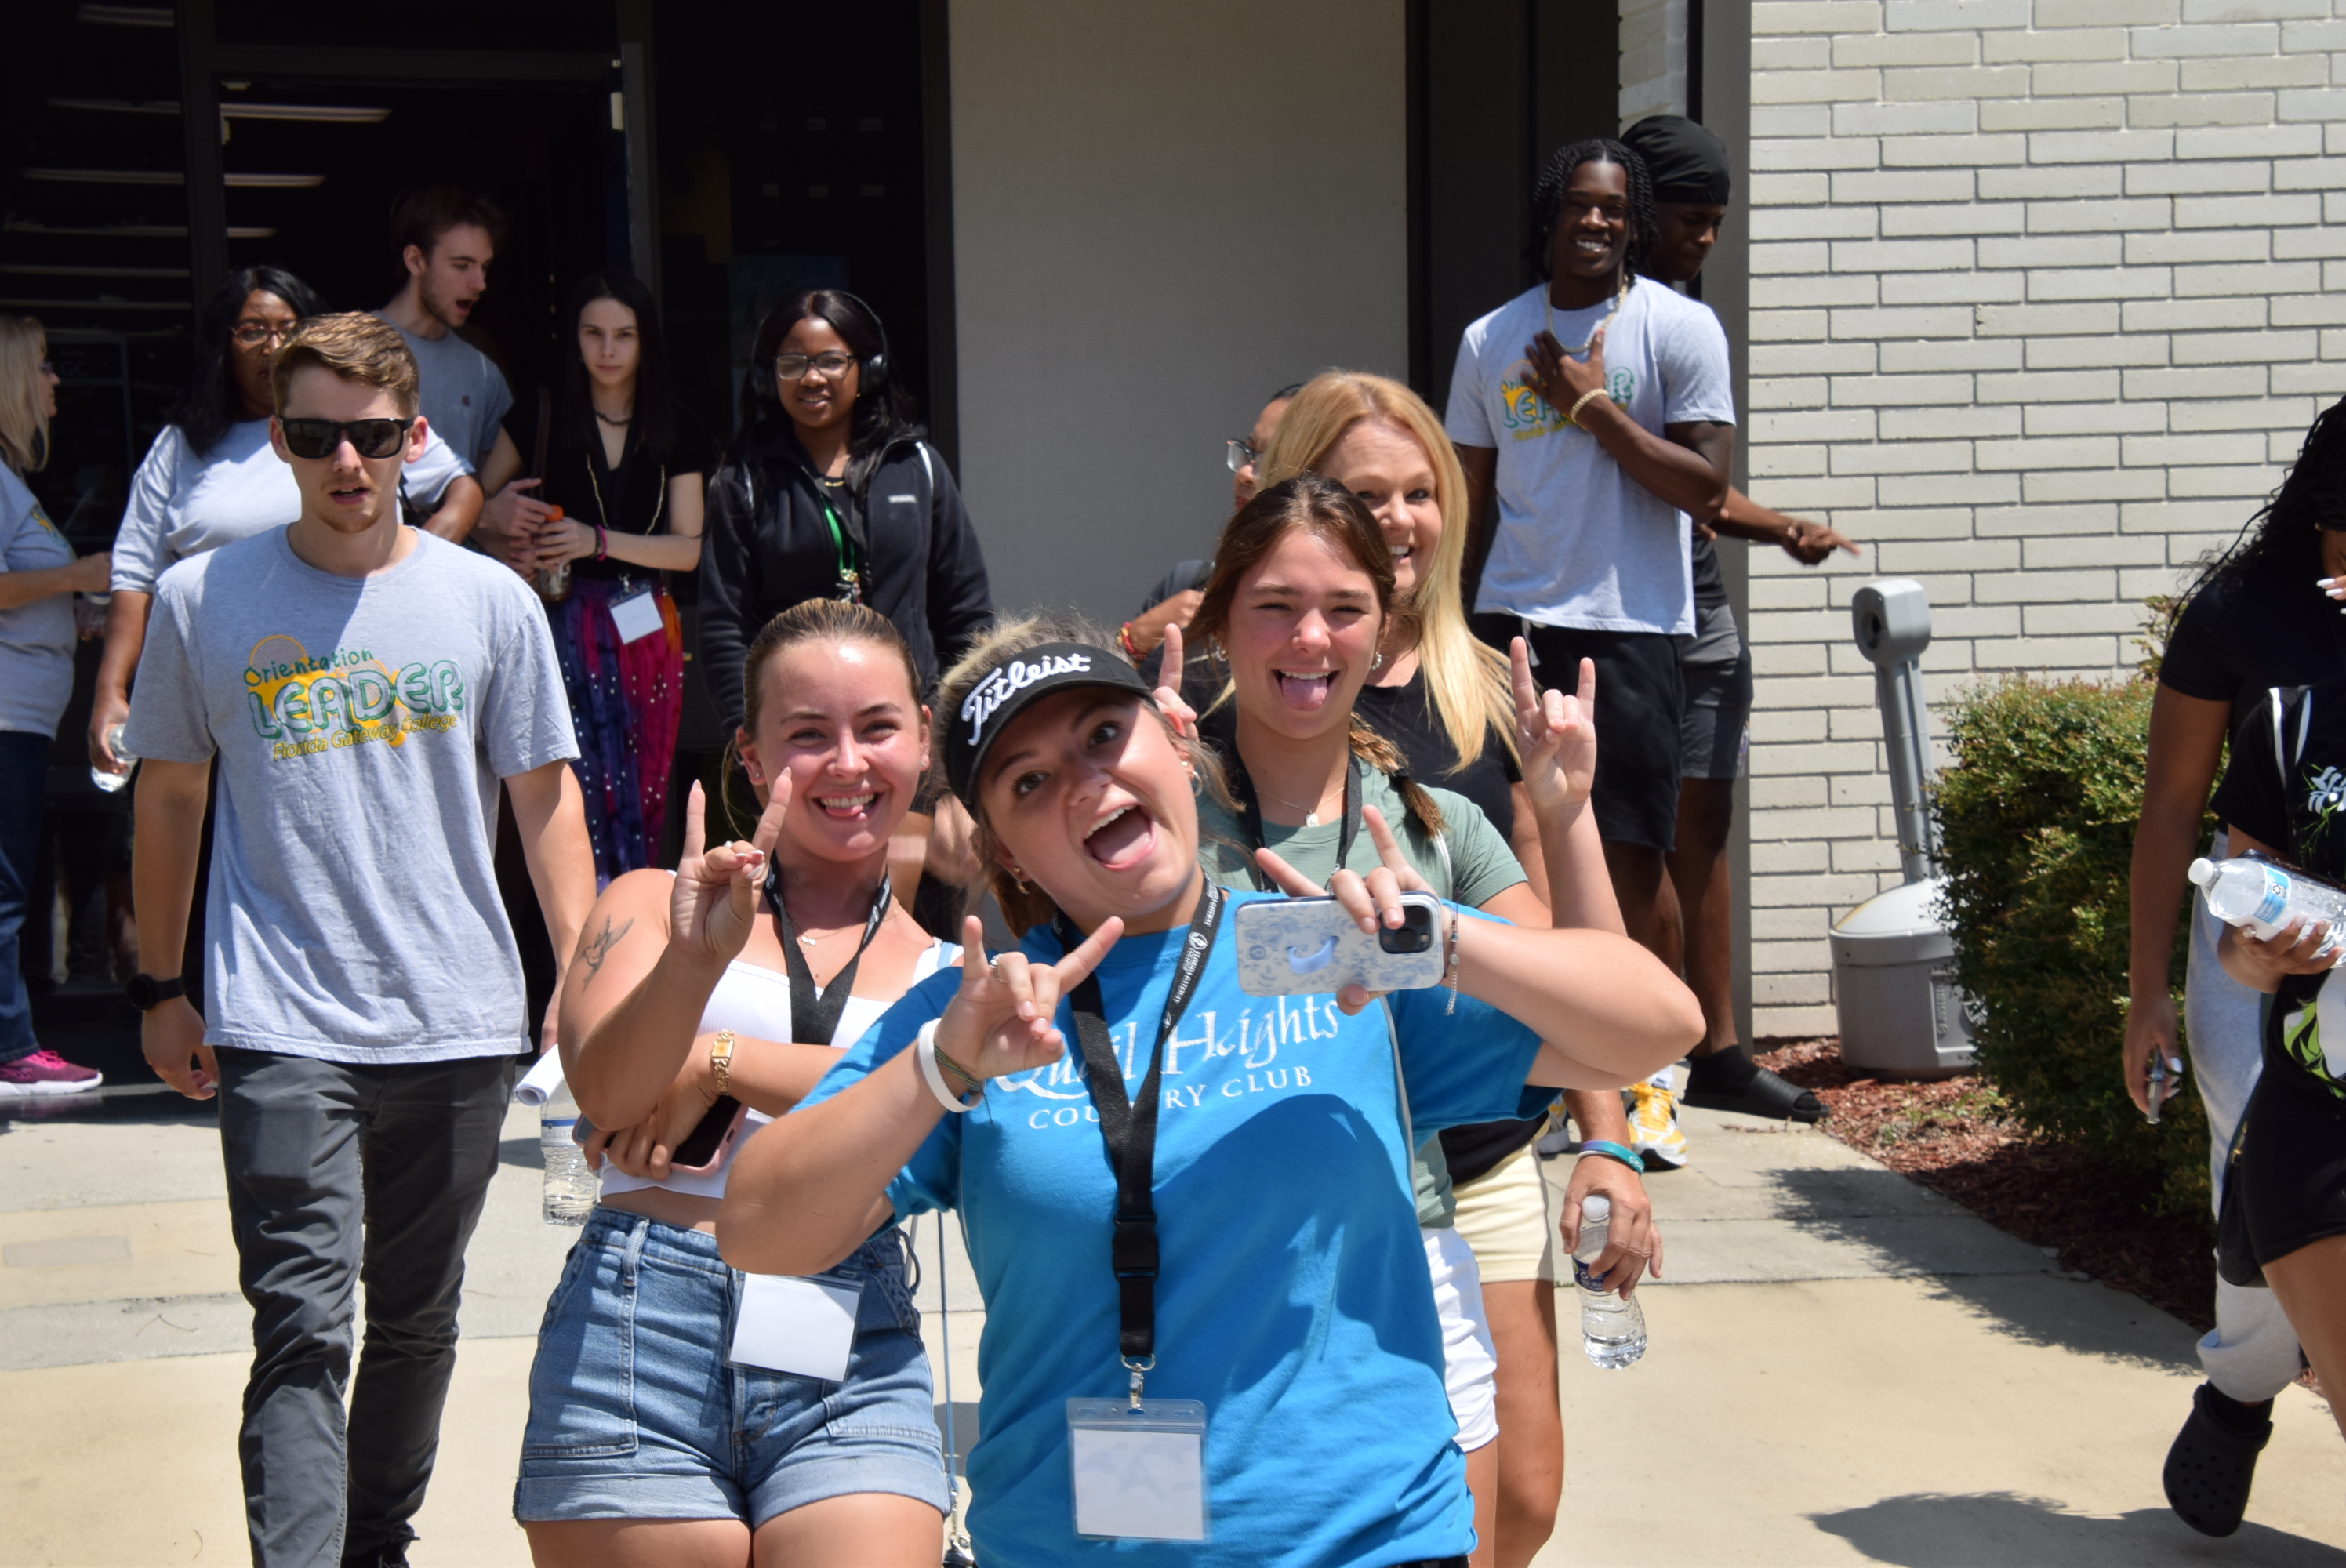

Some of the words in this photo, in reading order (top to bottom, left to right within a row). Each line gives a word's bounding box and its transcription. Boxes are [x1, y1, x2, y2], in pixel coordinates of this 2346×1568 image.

[1502, 366, 1634, 429] LEAR
[244, 648, 373, 687] Orientation
[249, 660, 464, 739] LEADER
[961, 653, 1091, 746] Titleist
[274, 735, 329, 761] Florida
[332, 721, 398, 748] Gateway
[402, 713, 458, 735] College
[1172, 975, 1191, 1004] GATEWAY
[1186, 950, 1201, 975] FLORIDA
[1028, 1084, 1207, 1129] COURY
[1221, 1066, 1312, 1098] CLUB
